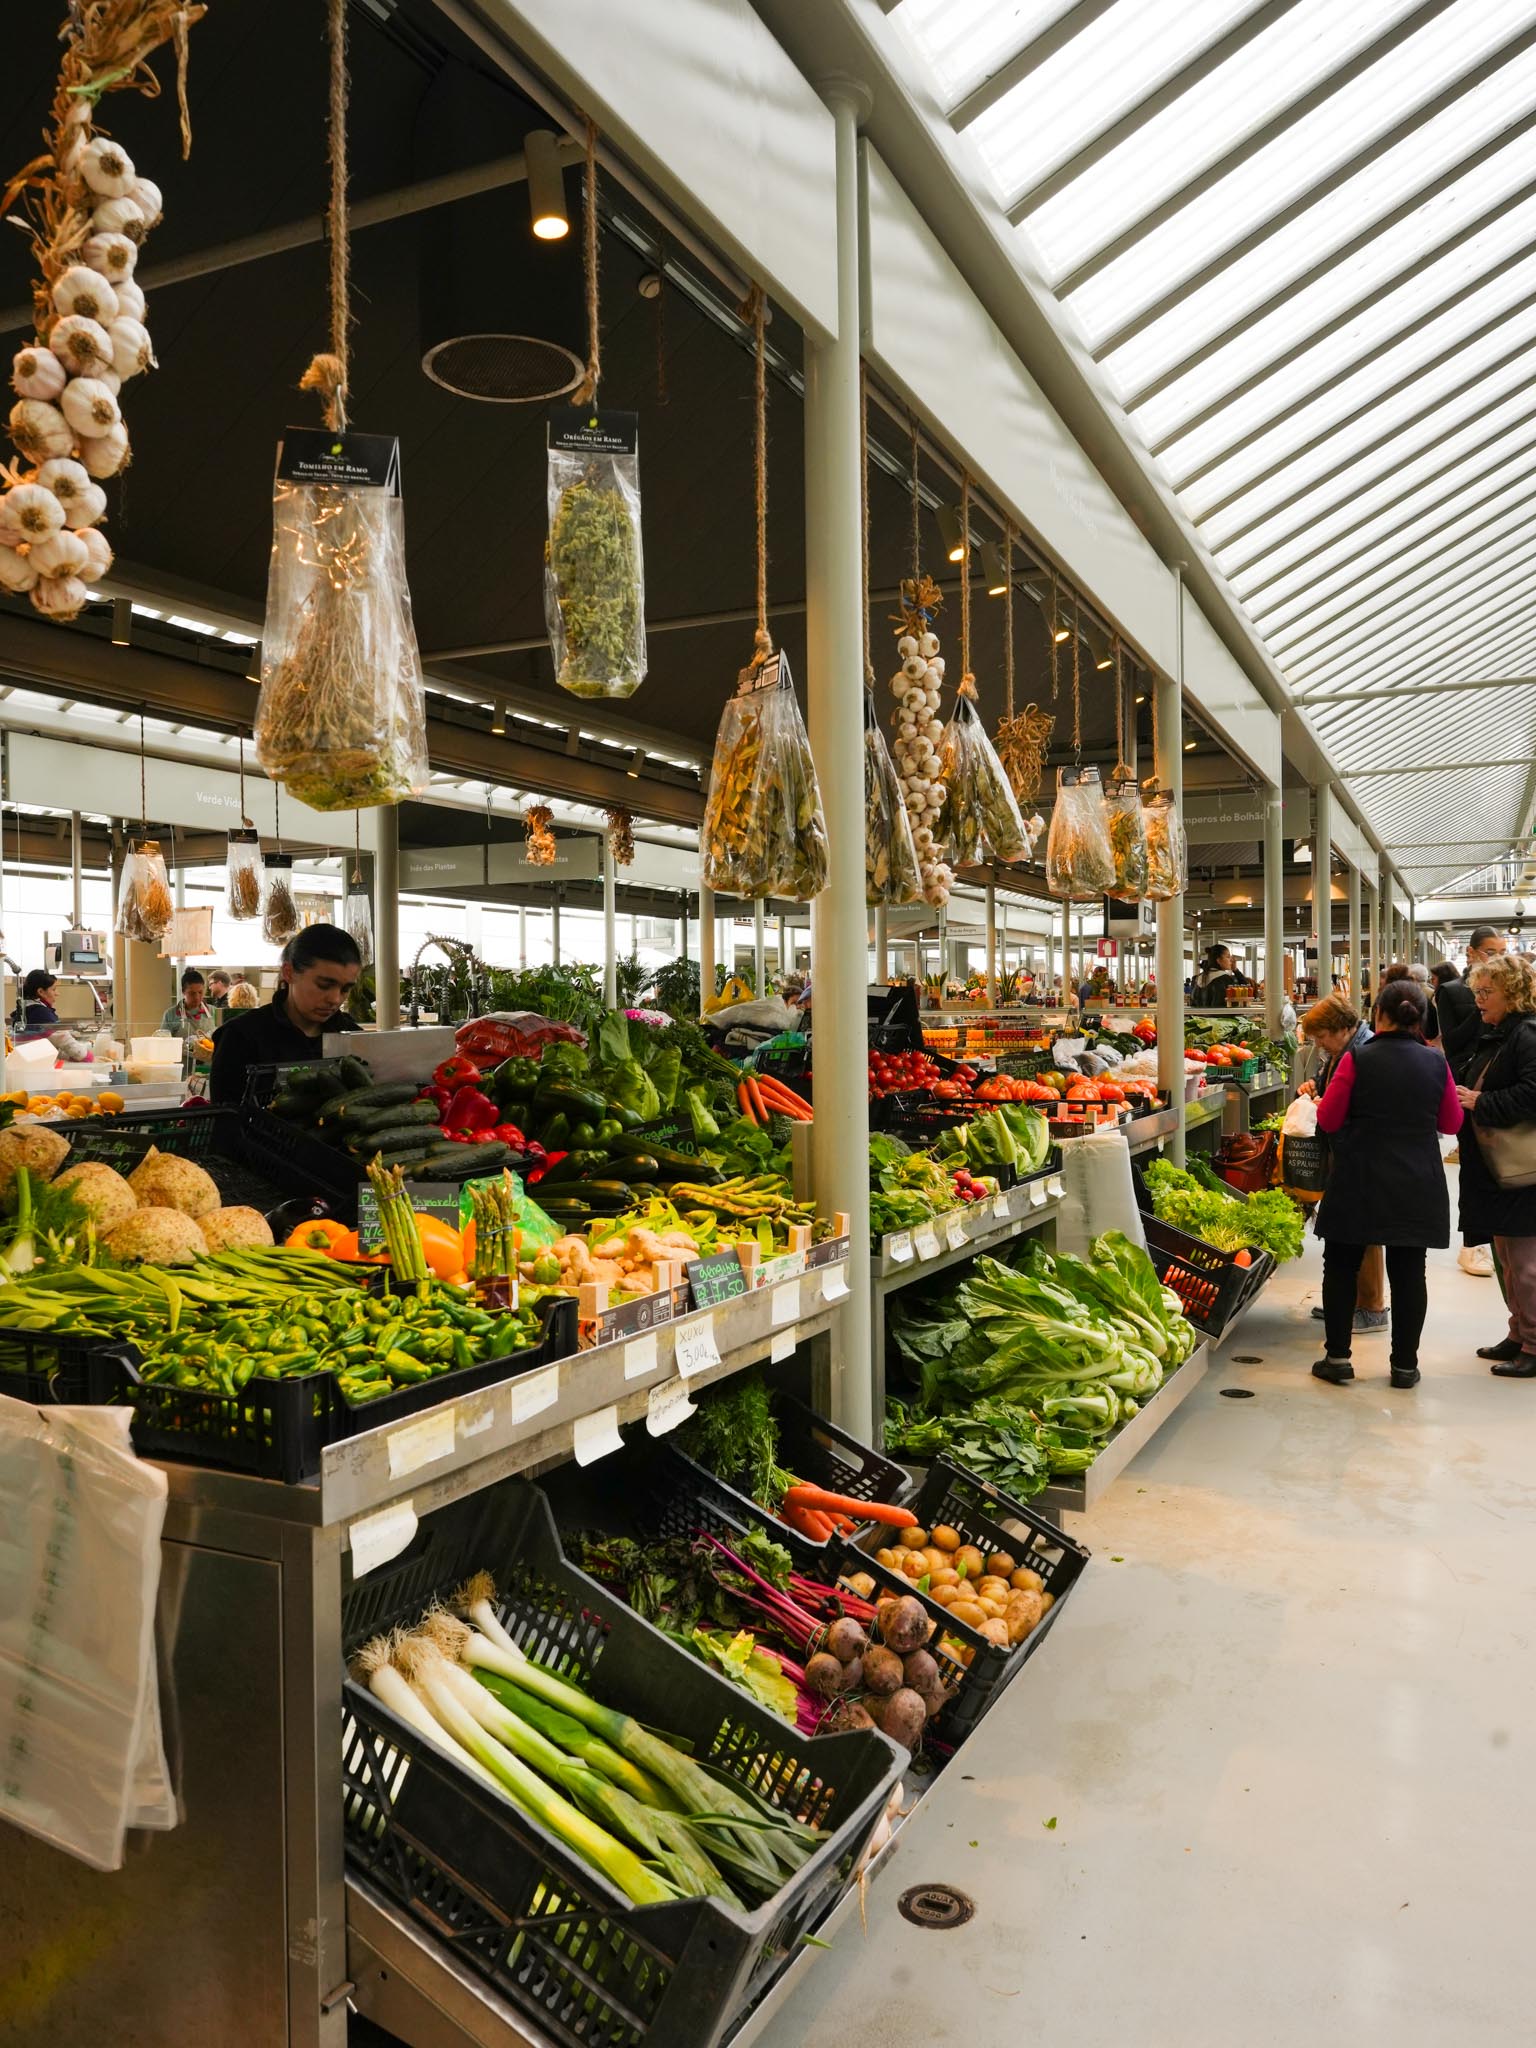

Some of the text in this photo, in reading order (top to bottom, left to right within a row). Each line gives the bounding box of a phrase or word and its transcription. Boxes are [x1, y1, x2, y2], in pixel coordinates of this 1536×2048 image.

[345, 465, 368, 474] RAMO
[195, 791, 242, 809] Verde Vida
[1219, 813, 1232, 822] do
[434, 862, 457, 871] Plantas
